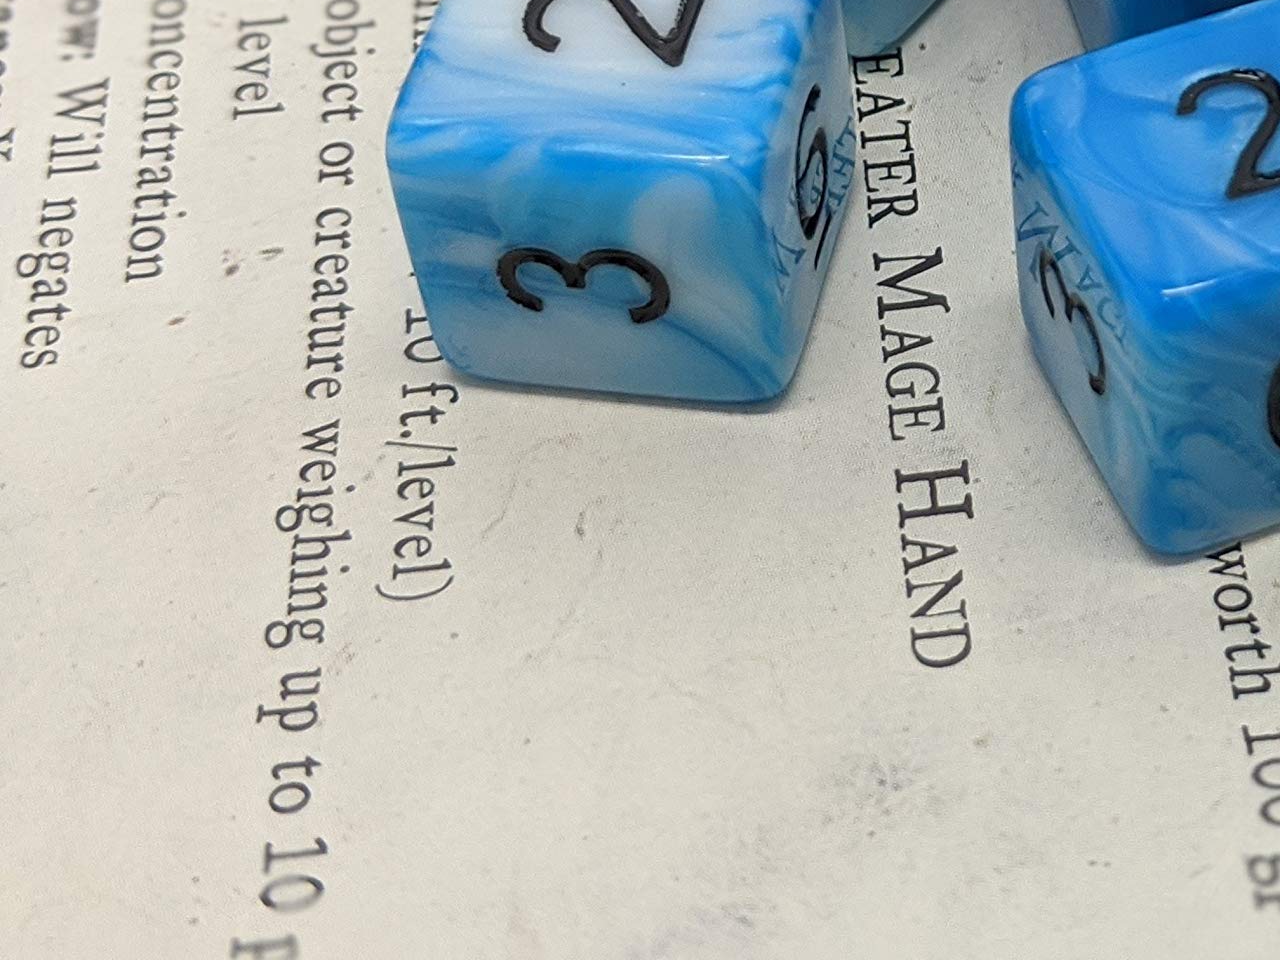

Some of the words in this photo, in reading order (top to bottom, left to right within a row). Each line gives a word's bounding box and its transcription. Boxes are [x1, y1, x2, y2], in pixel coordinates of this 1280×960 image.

[48, 77, 110, 179] Will
[232, 15, 289, 120] level
[318, 143, 356, 187] or
[851, 48, 919, 229] EATER
[15, 196, 77, 369] negates
[304, 205, 363, 399] creature
[496, 246, 672, 325] 3
[872, 247, 951, 441] MAGE
[264, 419, 356, 649] weighing
[375, 382, 460, 601] ft./level)
[894, 459, 975, 669] HAND
[257, 666, 322, 732] up
[268, 755, 321, 815] to
[259, 836, 328, 914] 10
